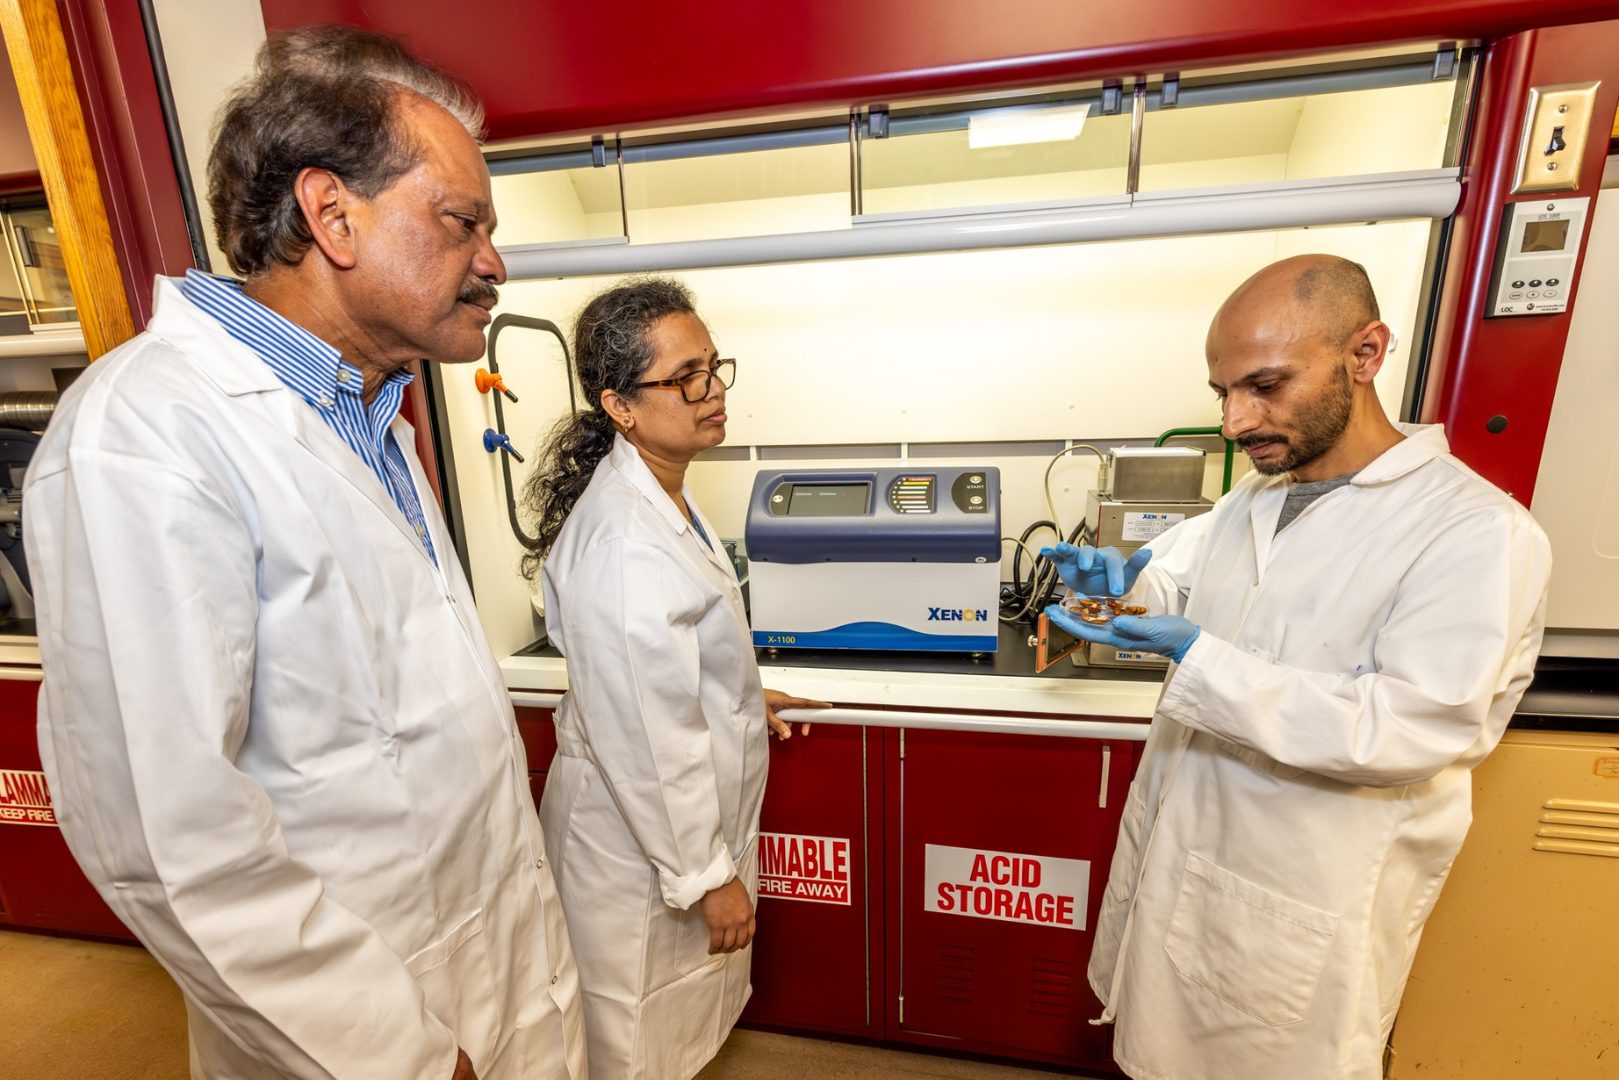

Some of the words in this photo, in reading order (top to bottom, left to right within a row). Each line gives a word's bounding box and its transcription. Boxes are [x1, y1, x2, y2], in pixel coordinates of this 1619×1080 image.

[927, 607, 988, 622] XENON
[768, 635, 796, 644] X-1100
[27, 810, 55, 821] FIRE
[969, 853, 1042, 888] ACID
[758, 879, 792, 894] FIRE
[795, 882, 845, 899] AWAY
[937, 882, 1074, 925] STORAGE
